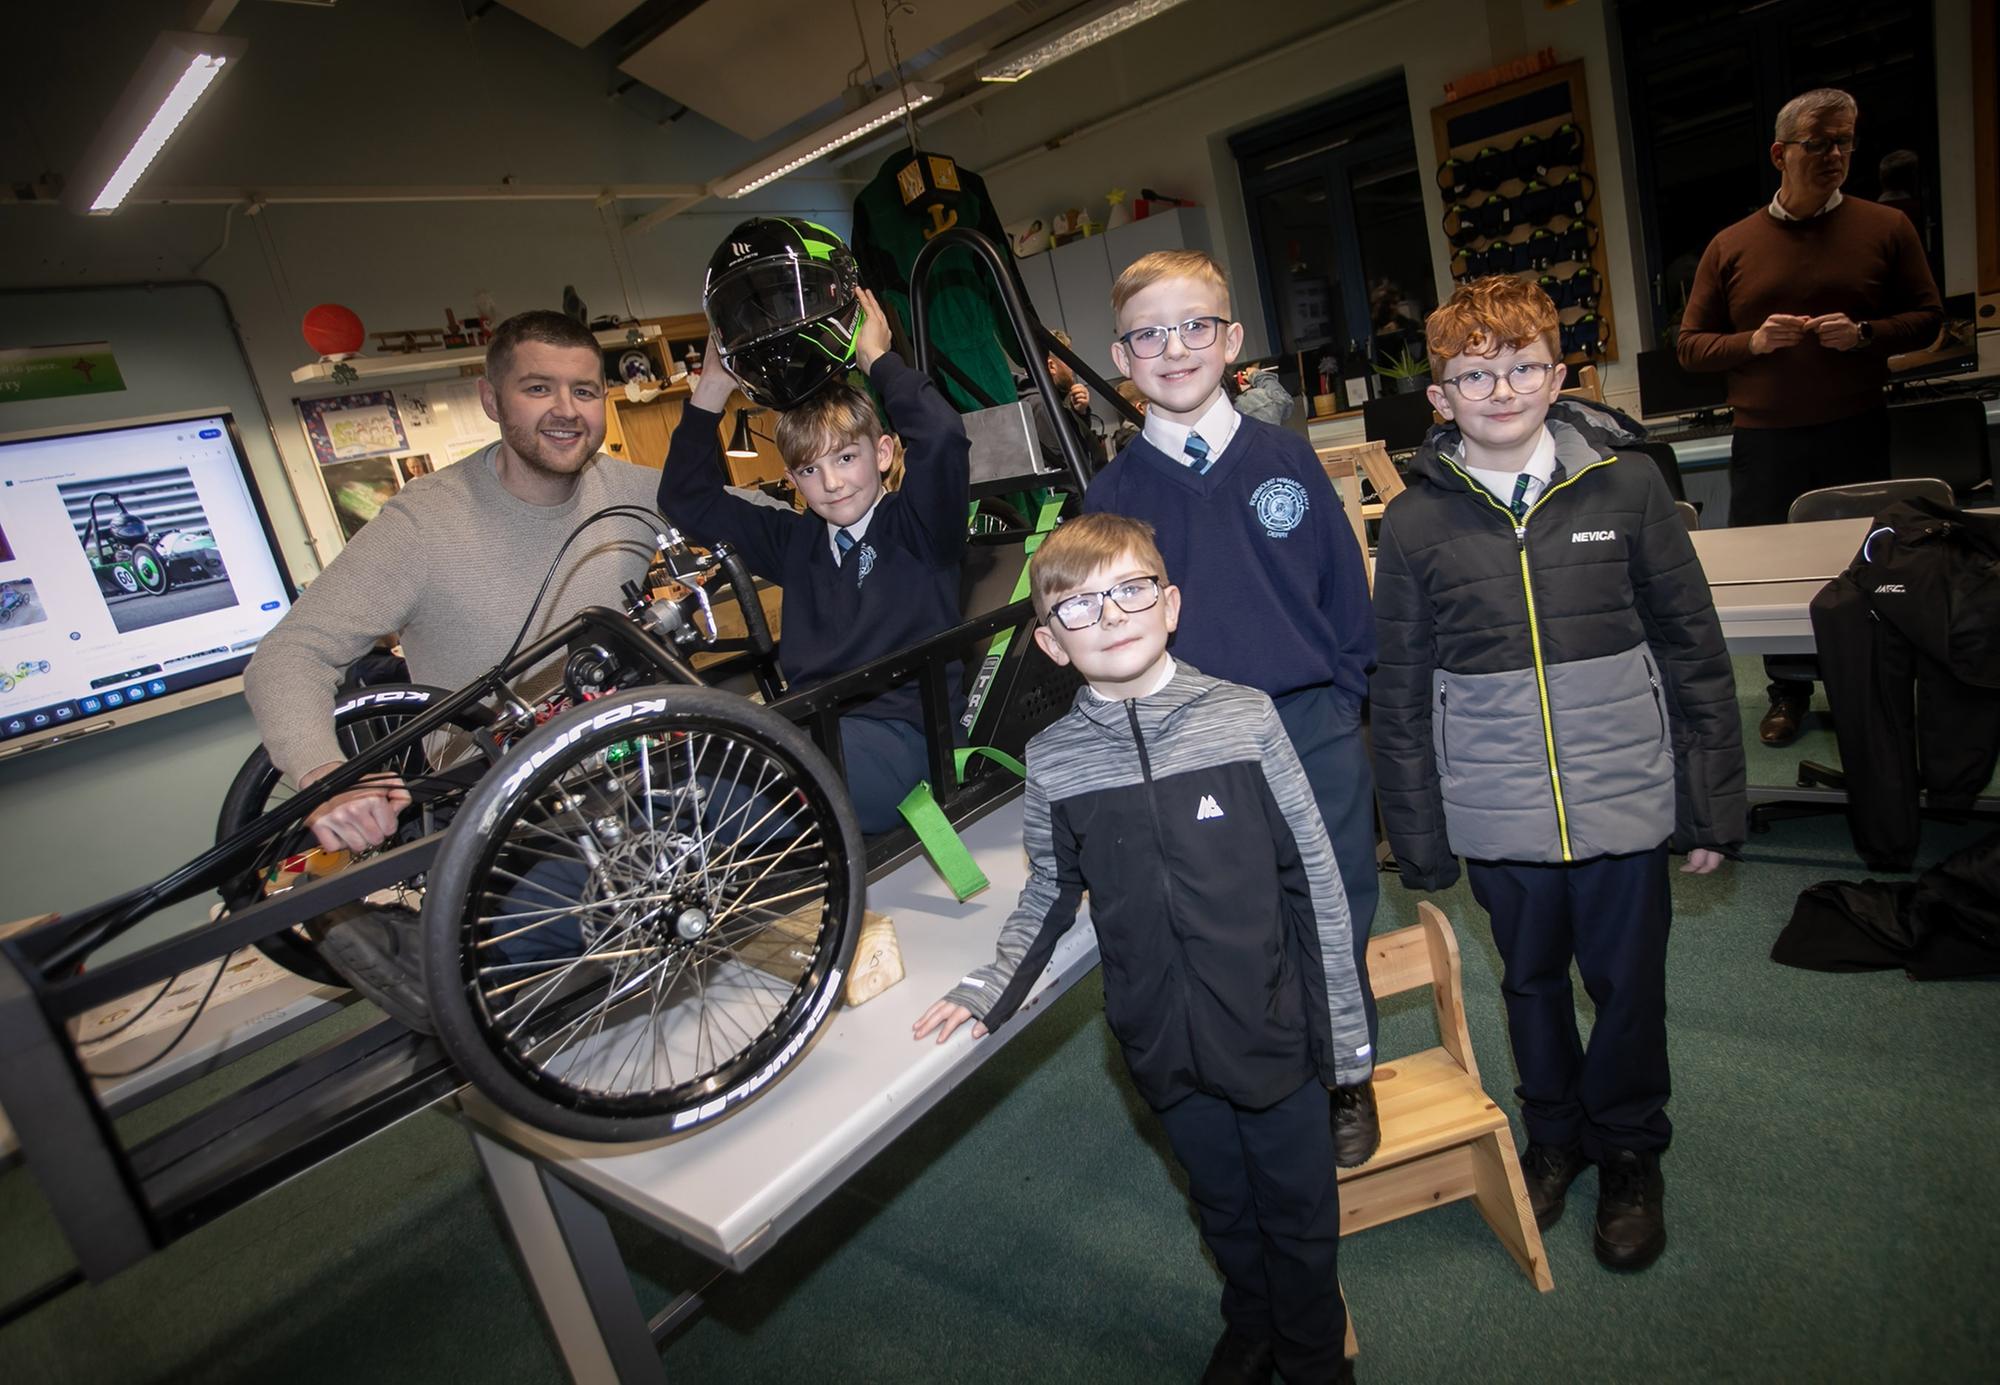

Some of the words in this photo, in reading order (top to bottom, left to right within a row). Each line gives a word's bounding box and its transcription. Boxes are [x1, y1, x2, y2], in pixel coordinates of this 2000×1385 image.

[1571, 530, 1616, 543] NEVICA
[116, 570, 133, 585] 60
[334, 691, 431, 715] KOJA
[502, 698, 667, 796] KOJAK
